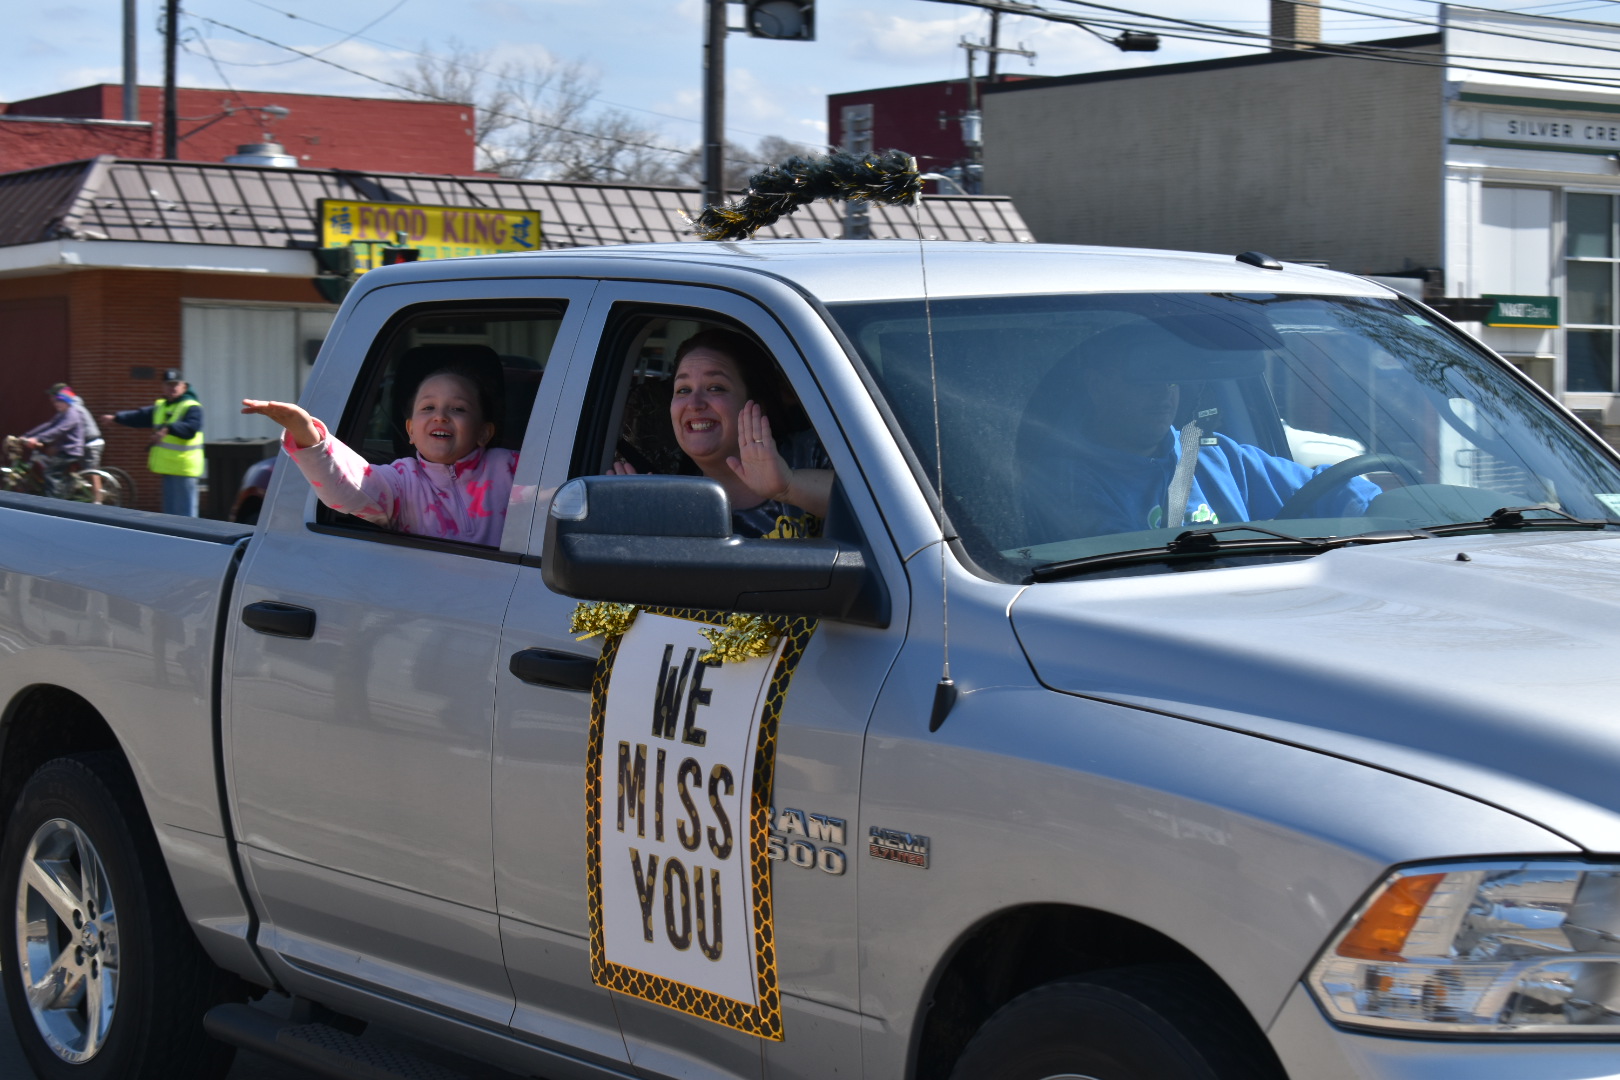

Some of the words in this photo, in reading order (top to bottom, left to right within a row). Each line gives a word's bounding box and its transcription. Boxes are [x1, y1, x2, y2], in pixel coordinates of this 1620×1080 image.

[1507, 120, 1573, 139] SILVER
[357, 206, 428, 242] FOOD
[441, 211, 508, 245] KING
[651, 643, 723, 748] WE
[616, 740, 735, 861] MISS
[628, 846, 723, 963] YOU
